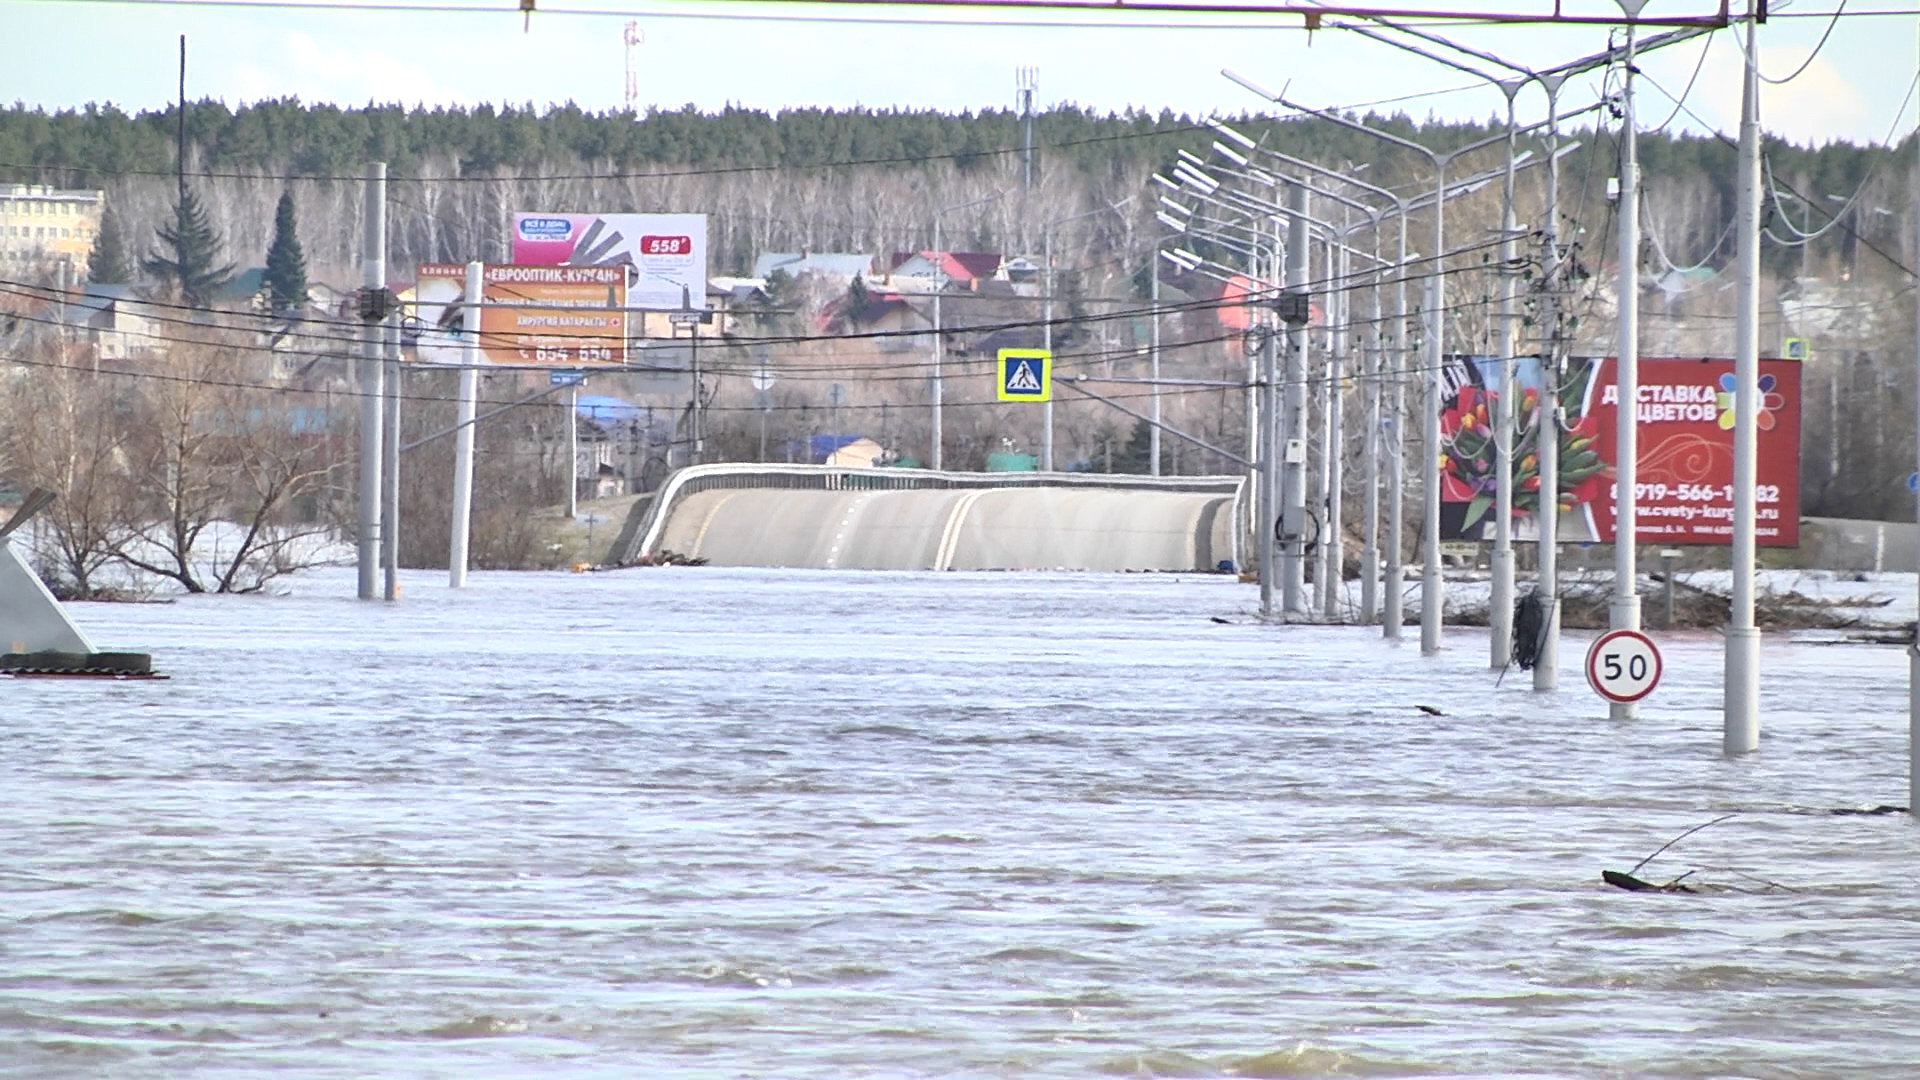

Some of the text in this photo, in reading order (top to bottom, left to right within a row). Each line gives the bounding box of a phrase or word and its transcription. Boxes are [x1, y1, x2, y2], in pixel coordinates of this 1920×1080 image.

[1602, 384, 1717, 405] ДСТАВКА
[1636, 404, 1717, 423] ЦВЕТОВ
[1605, 654, 1647, 681] 50
